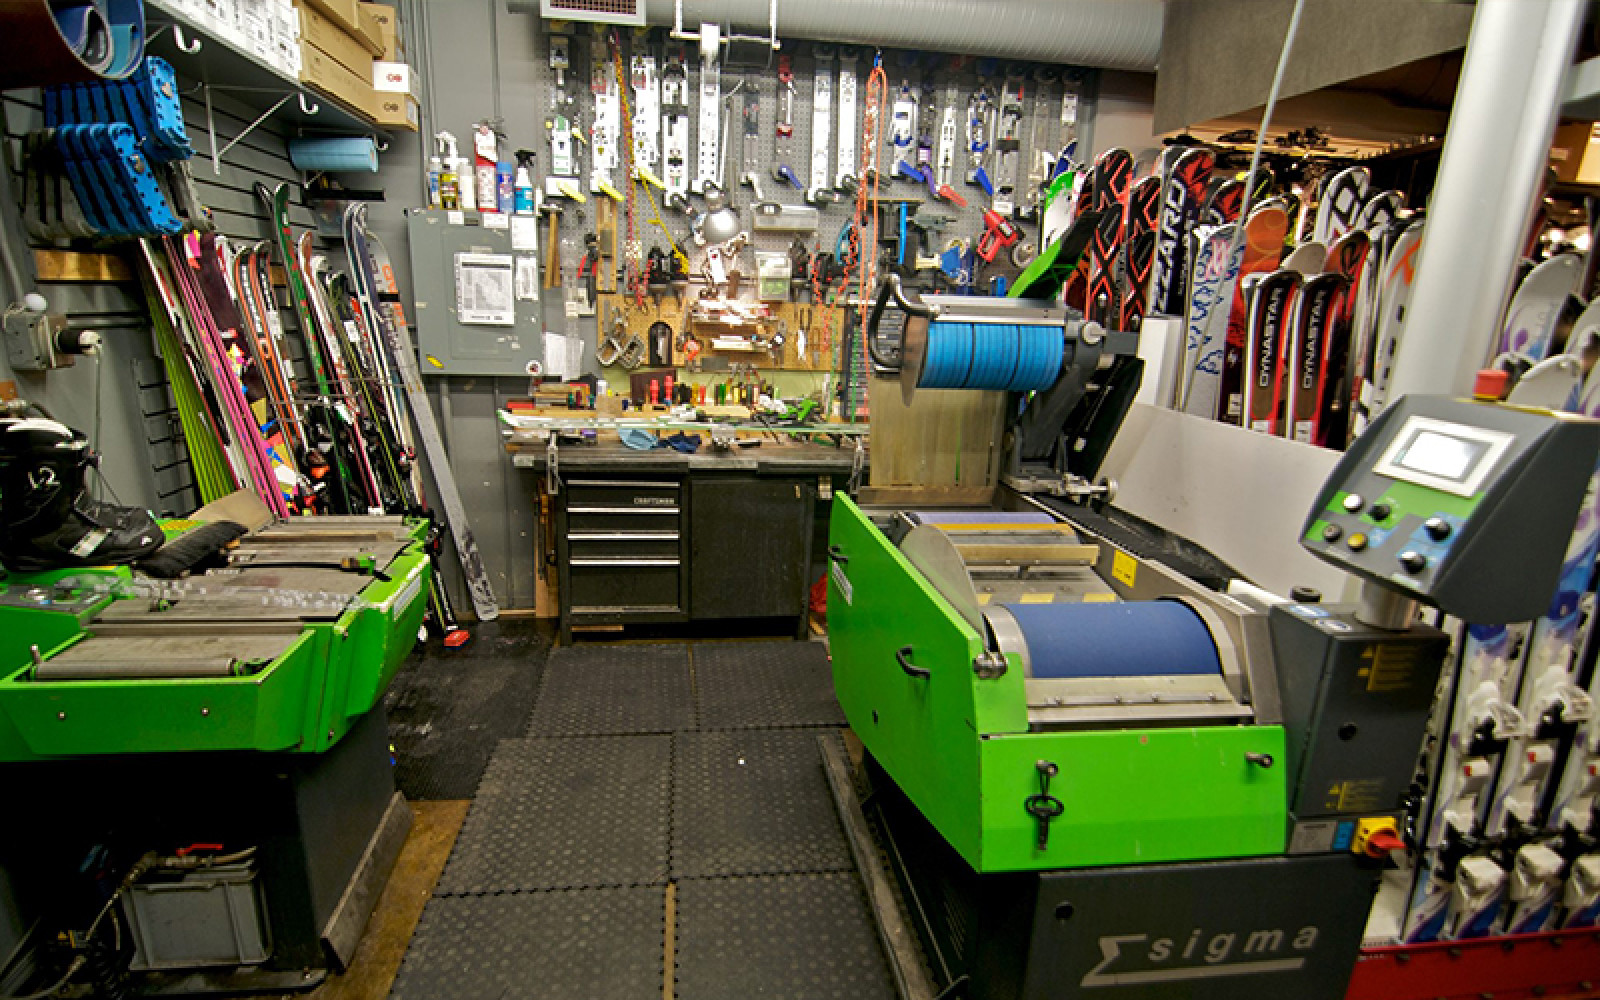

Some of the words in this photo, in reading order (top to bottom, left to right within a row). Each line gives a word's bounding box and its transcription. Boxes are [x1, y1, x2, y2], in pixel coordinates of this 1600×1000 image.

[1259, 287, 1283, 387] DYNASTAR
[633, 496, 675, 505] CRAFTSMAN
[1148, 925, 1319, 962] sigma
